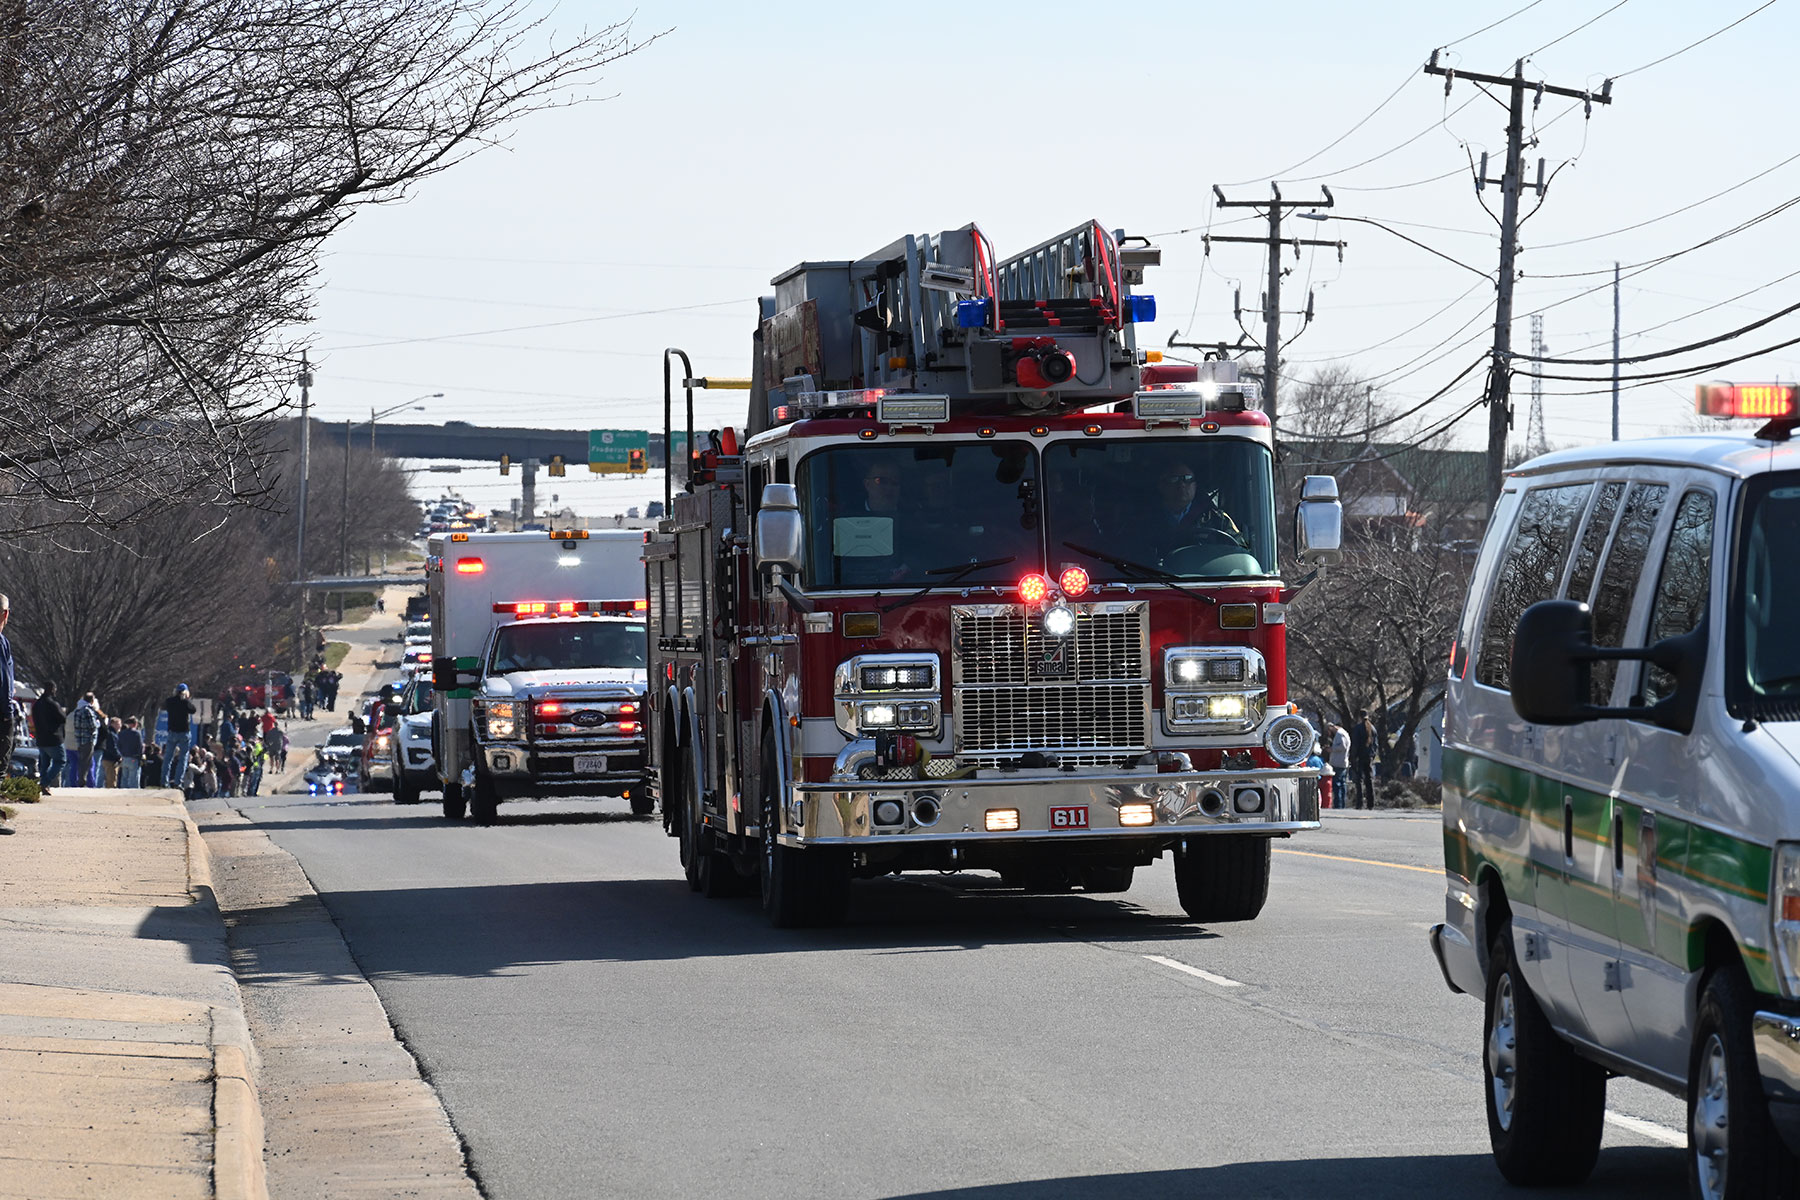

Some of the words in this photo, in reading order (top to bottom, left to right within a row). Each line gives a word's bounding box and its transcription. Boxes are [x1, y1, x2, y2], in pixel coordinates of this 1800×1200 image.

[1038, 660, 1066, 672] smeal
[579, 713, 598, 722] Ford
[1054, 809, 1086, 826] 611
